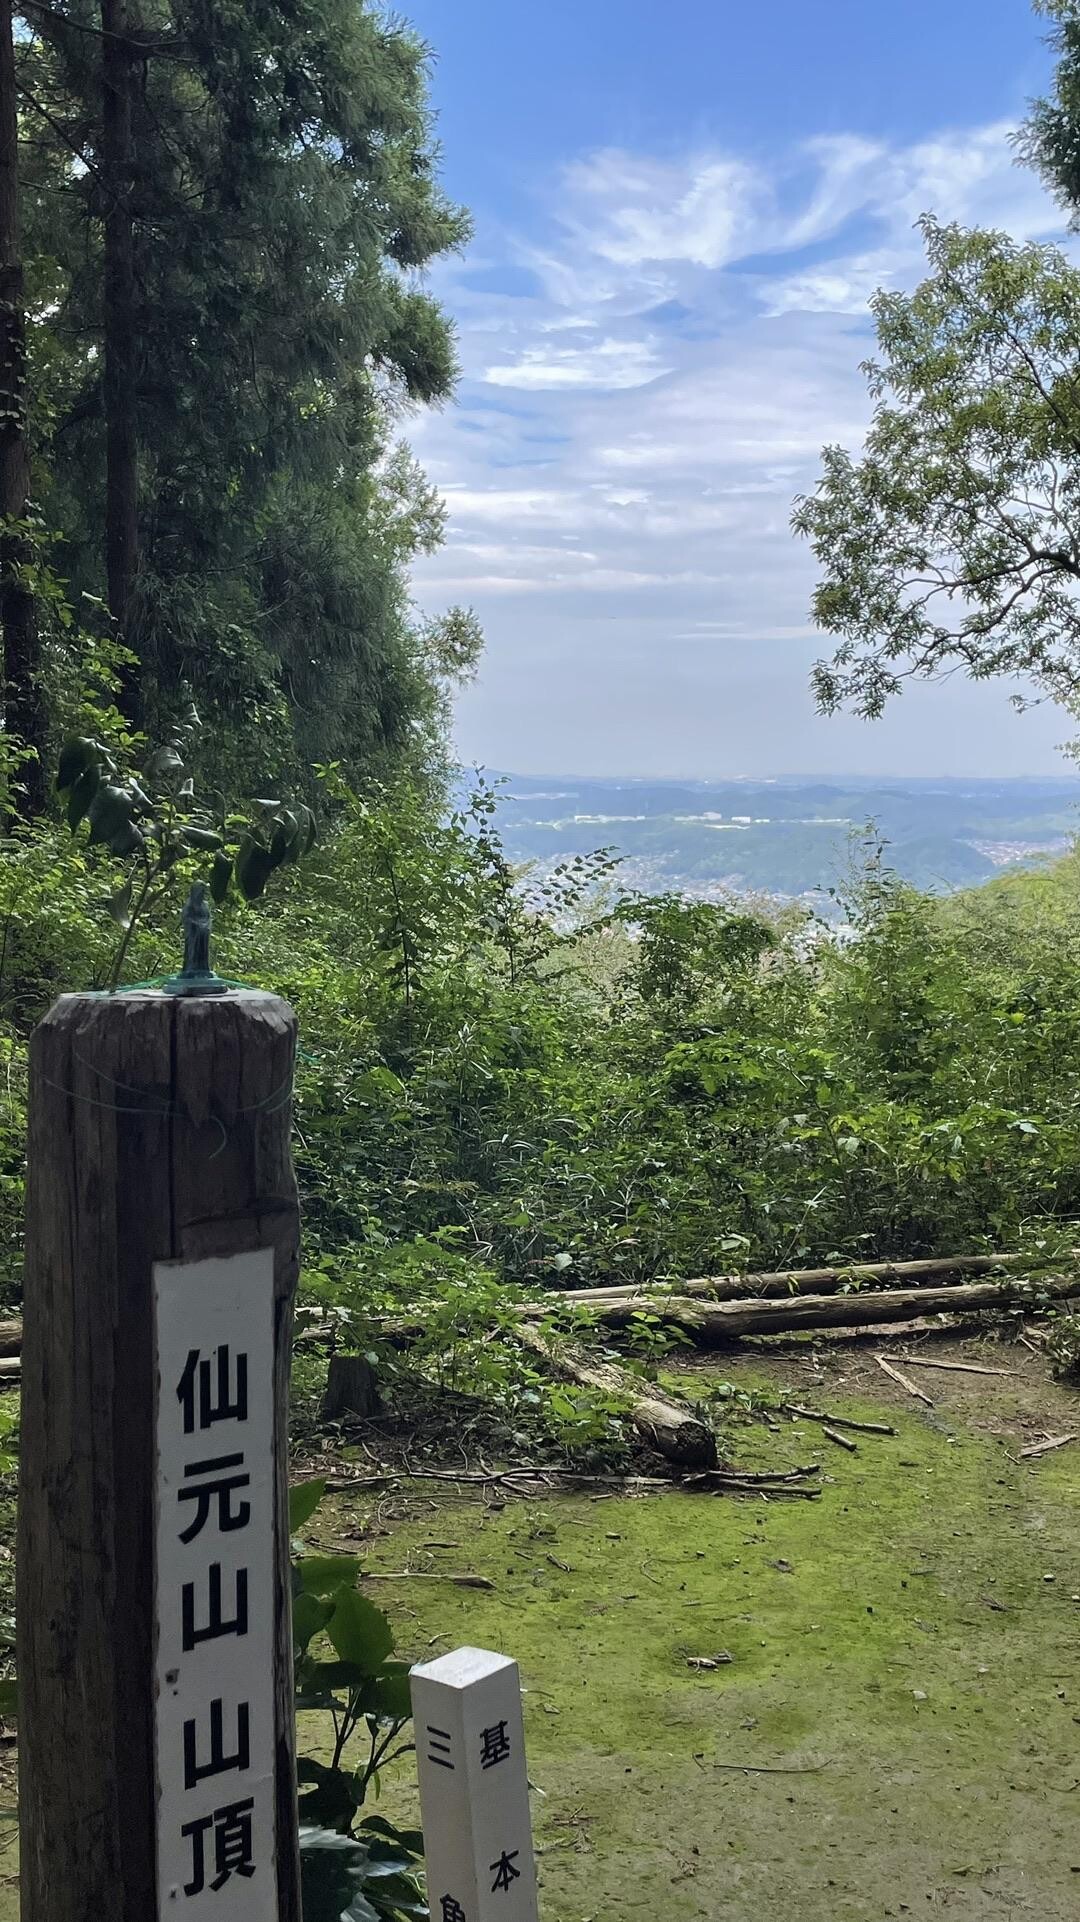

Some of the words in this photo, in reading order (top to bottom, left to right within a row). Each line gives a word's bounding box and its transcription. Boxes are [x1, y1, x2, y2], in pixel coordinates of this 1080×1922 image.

[176, 1343, 256, 1898] 仙元山山頂
[479, 1720, 521, 1893] 基本
